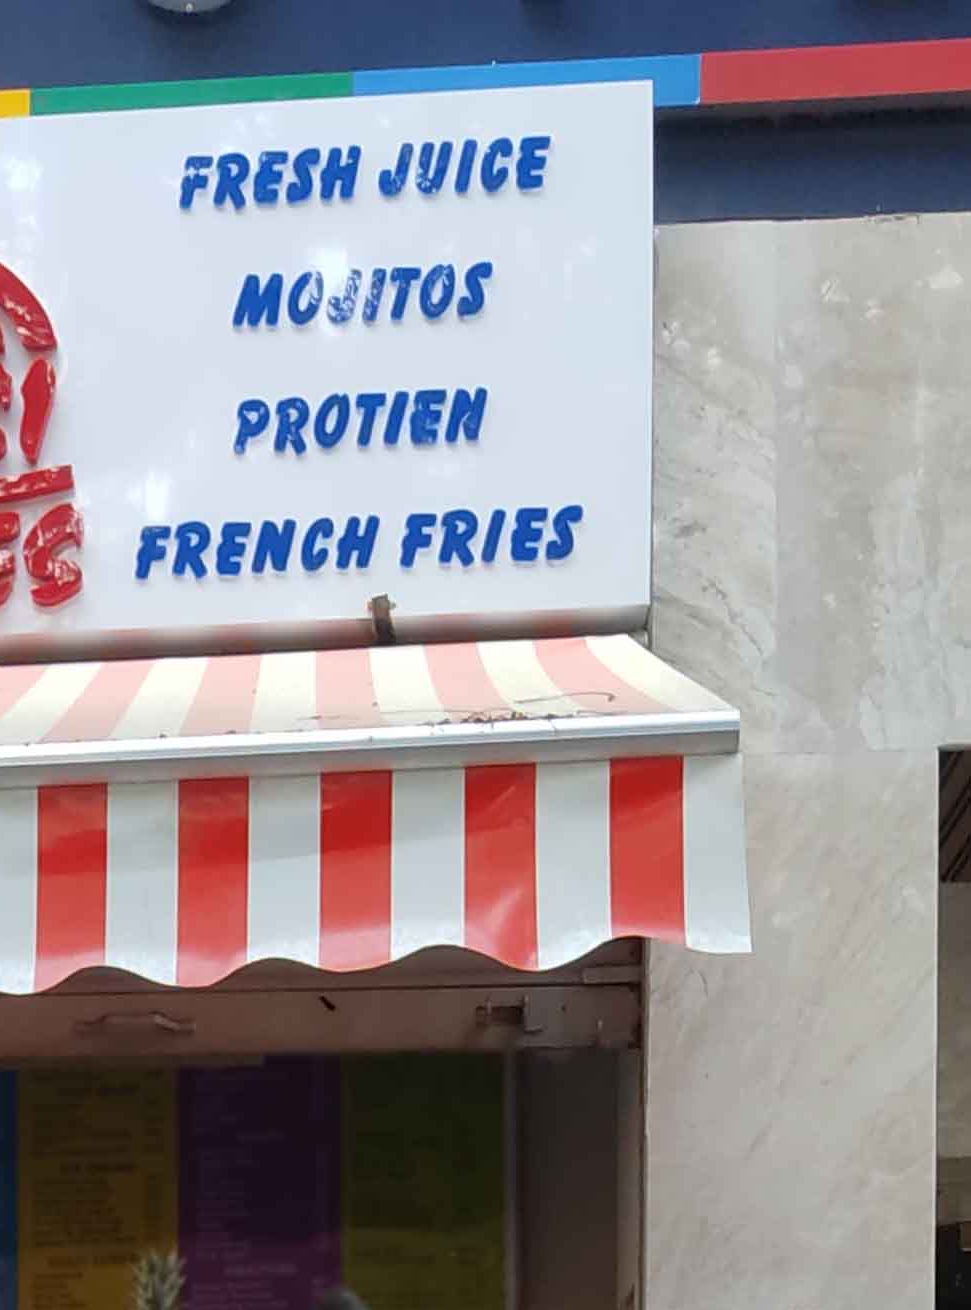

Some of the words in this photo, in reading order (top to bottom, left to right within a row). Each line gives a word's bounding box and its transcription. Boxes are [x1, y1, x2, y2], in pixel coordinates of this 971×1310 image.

[180, 145, 362, 210] FRESH
[378, 135, 552, 198] JUICE
[232, 260, 494, 328] MOJITOS
[233, 386, 488, 456] PROTIEN
[134, 515, 380, 581] FRENCH
[398, 504, 584, 570] FRIES
